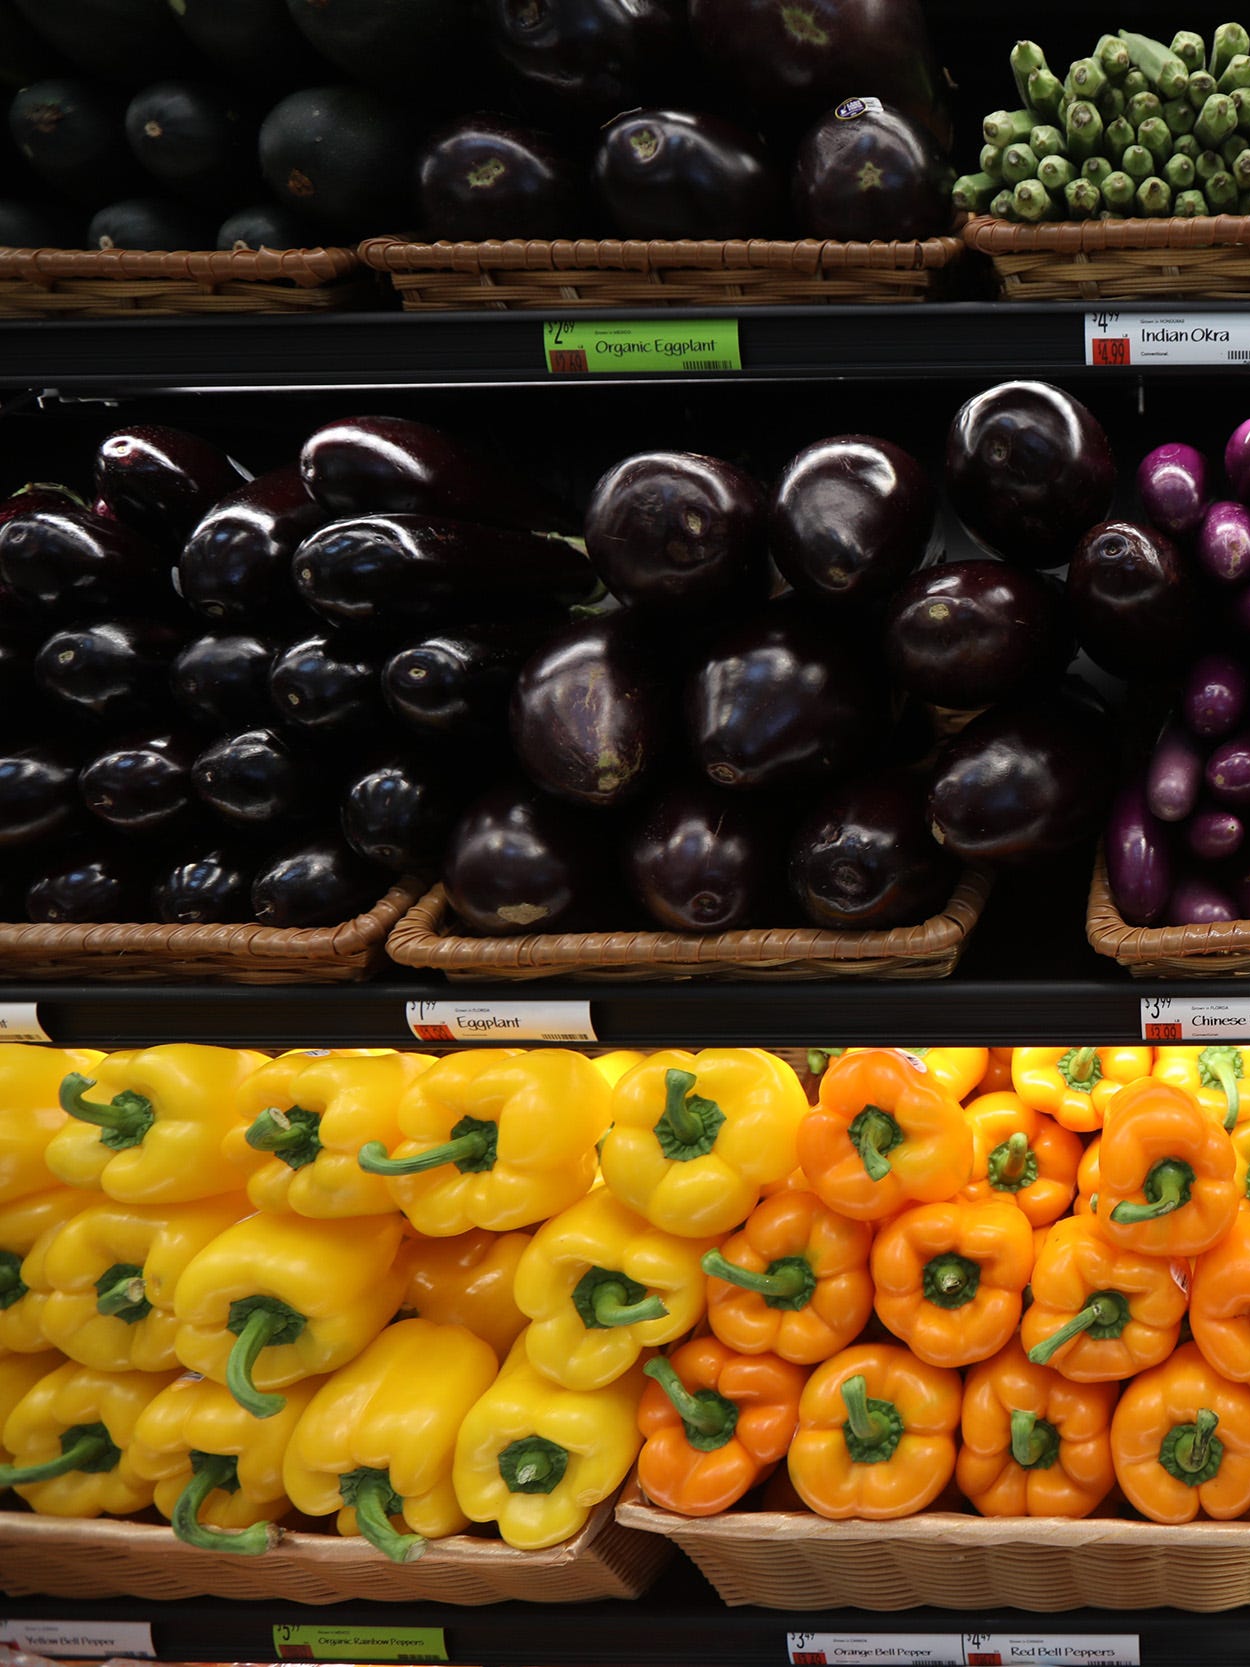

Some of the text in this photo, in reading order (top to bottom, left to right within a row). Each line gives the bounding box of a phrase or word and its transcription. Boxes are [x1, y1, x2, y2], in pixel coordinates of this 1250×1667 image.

[1141, 328, 1230, 342] Indian Okra
[595, 339, 717, 358] Organic Eggplant
[456, 1015, 521, 1031] Eggplant
[1191, 1015, 1247, 1027] Chinese
[834, 1648, 932, 1657] Orange Bell Pepper
[1011, 1647, 1116, 1658] Red Bell Peppers
